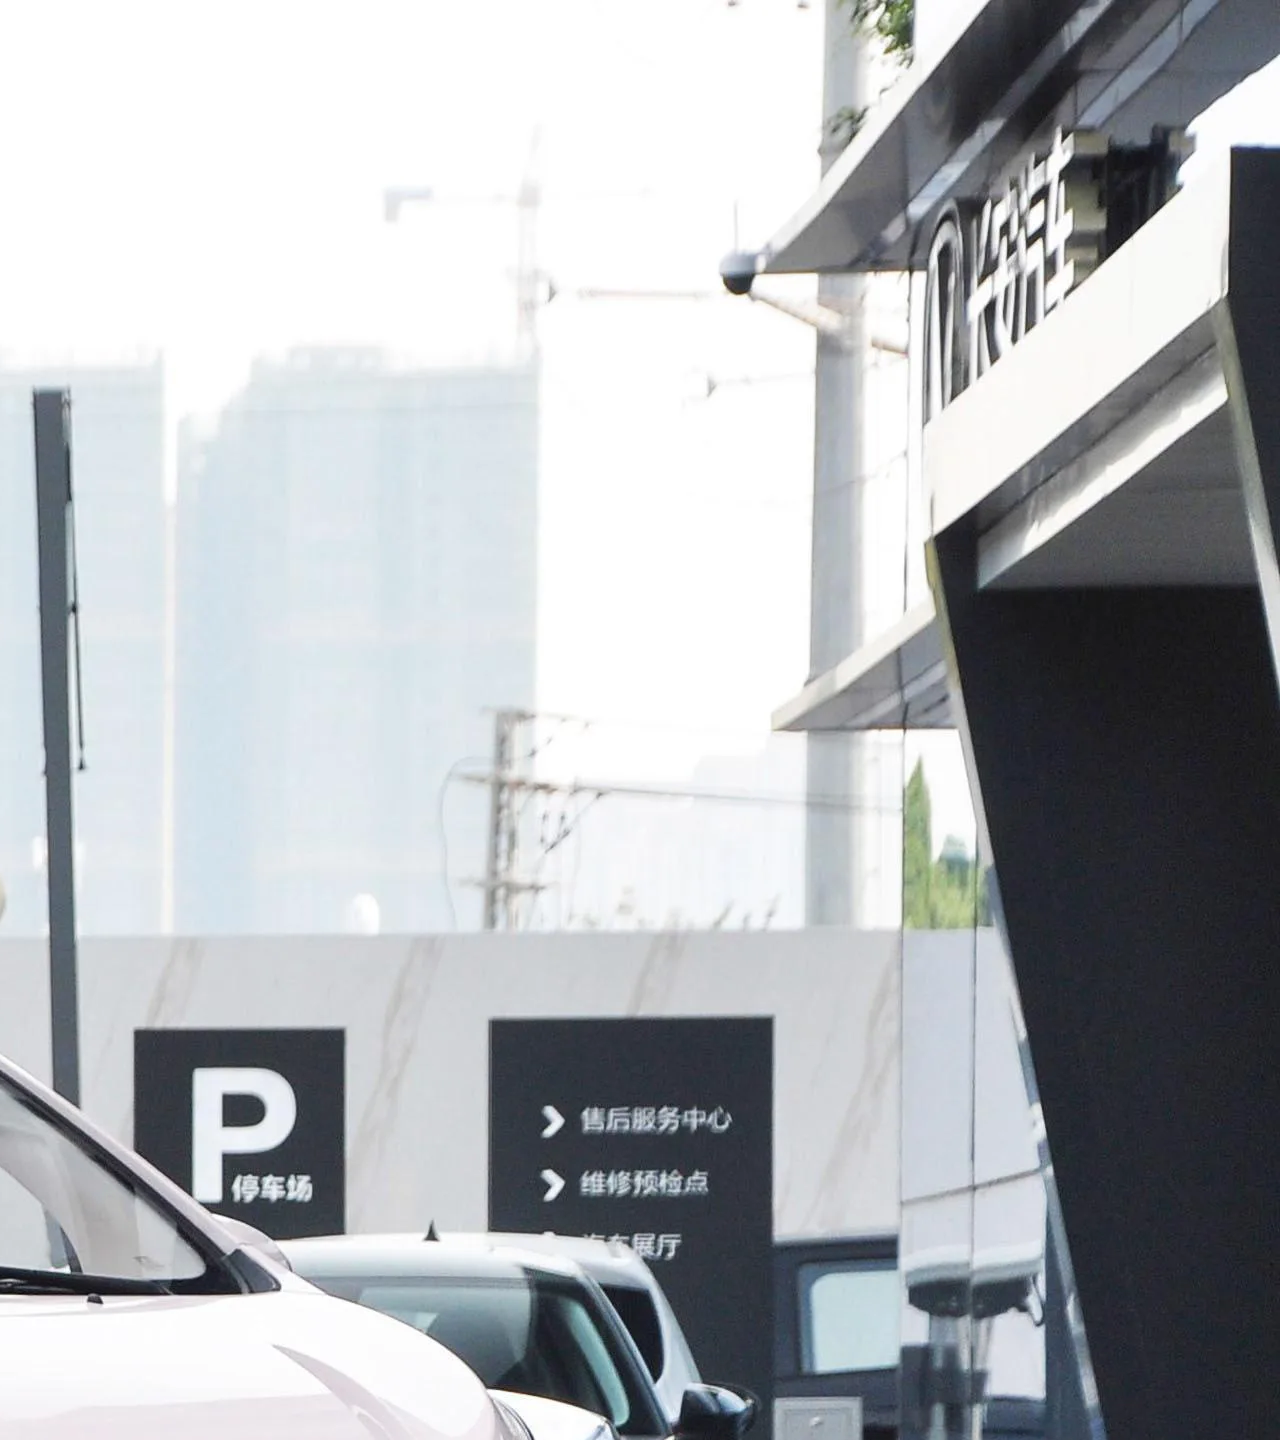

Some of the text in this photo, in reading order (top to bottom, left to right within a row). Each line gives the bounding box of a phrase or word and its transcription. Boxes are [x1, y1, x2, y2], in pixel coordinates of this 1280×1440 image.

[581, 1105, 733, 1133] 售后服务中心
[192, 1067, 297, 1204] P
[231, 1174, 313, 1203] 停车场
[580, 1169, 709, 1197] 维修预检点
